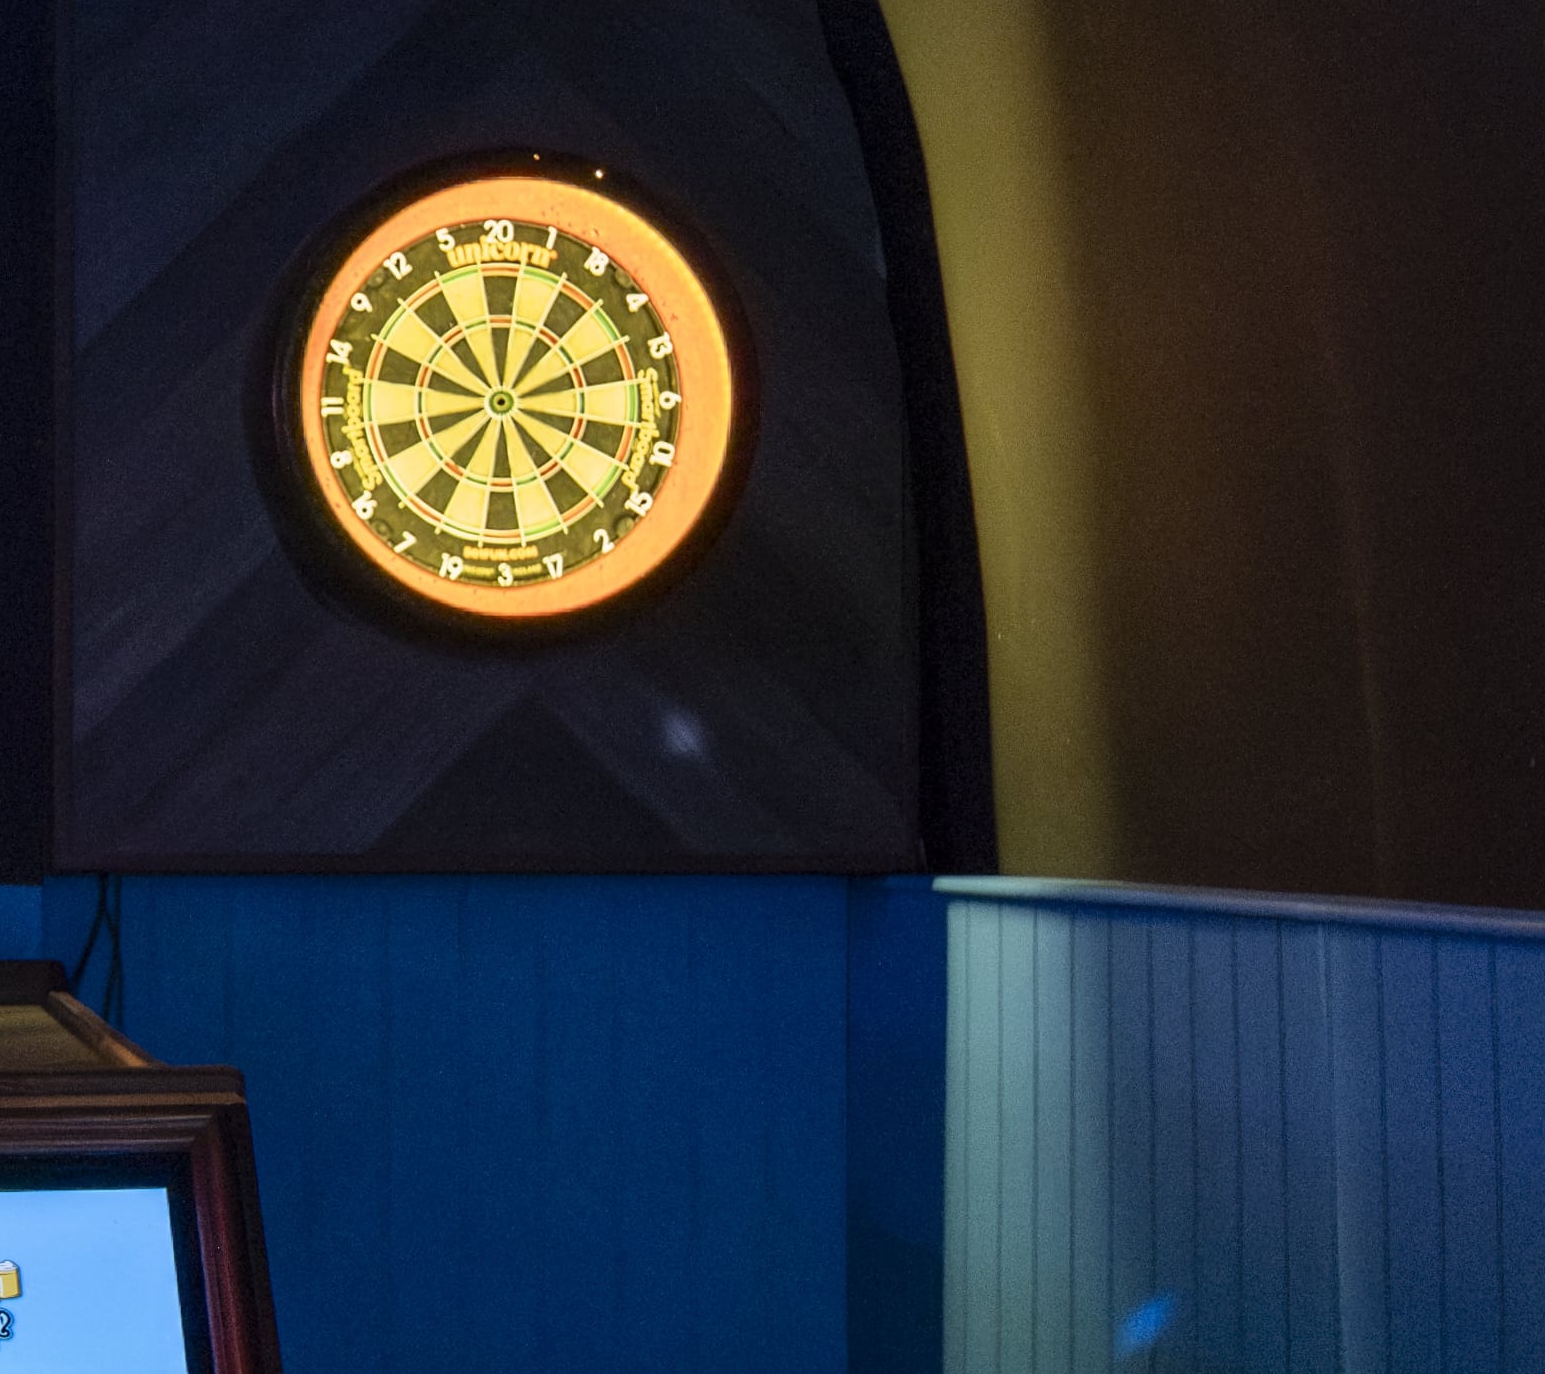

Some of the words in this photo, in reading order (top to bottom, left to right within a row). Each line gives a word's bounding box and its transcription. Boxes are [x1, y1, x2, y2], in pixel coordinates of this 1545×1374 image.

[436, 228, 455, 252] 5
[484, 220, 514, 243] 20
[545, 226, 557, 249] 1
[445, 235, 553, 268] unicorn
[584, 246, 609, 276] 18
[383, 252, 413, 280] 12
[350, 292, 372, 313] 9
[626, 293, 648, 313] 4
[326, 339, 353, 364] 14
[647, 331, 674, 359] 13
[321, 397, 345, 417] 11
[659, 390, 681, 410] 6
[330, 450, 352, 469] 8
[649, 440, 675, 467] 10
[352, 490, 378, 520] 16
[625, 491, 653, 517] 15
[393, 531, 417, 554] 7
[593, 528, 614, 553] 2
[439, 552, 463, 580] 19
[497, 562, 513, 587] 3
[542, 553, 563, 579] 17
